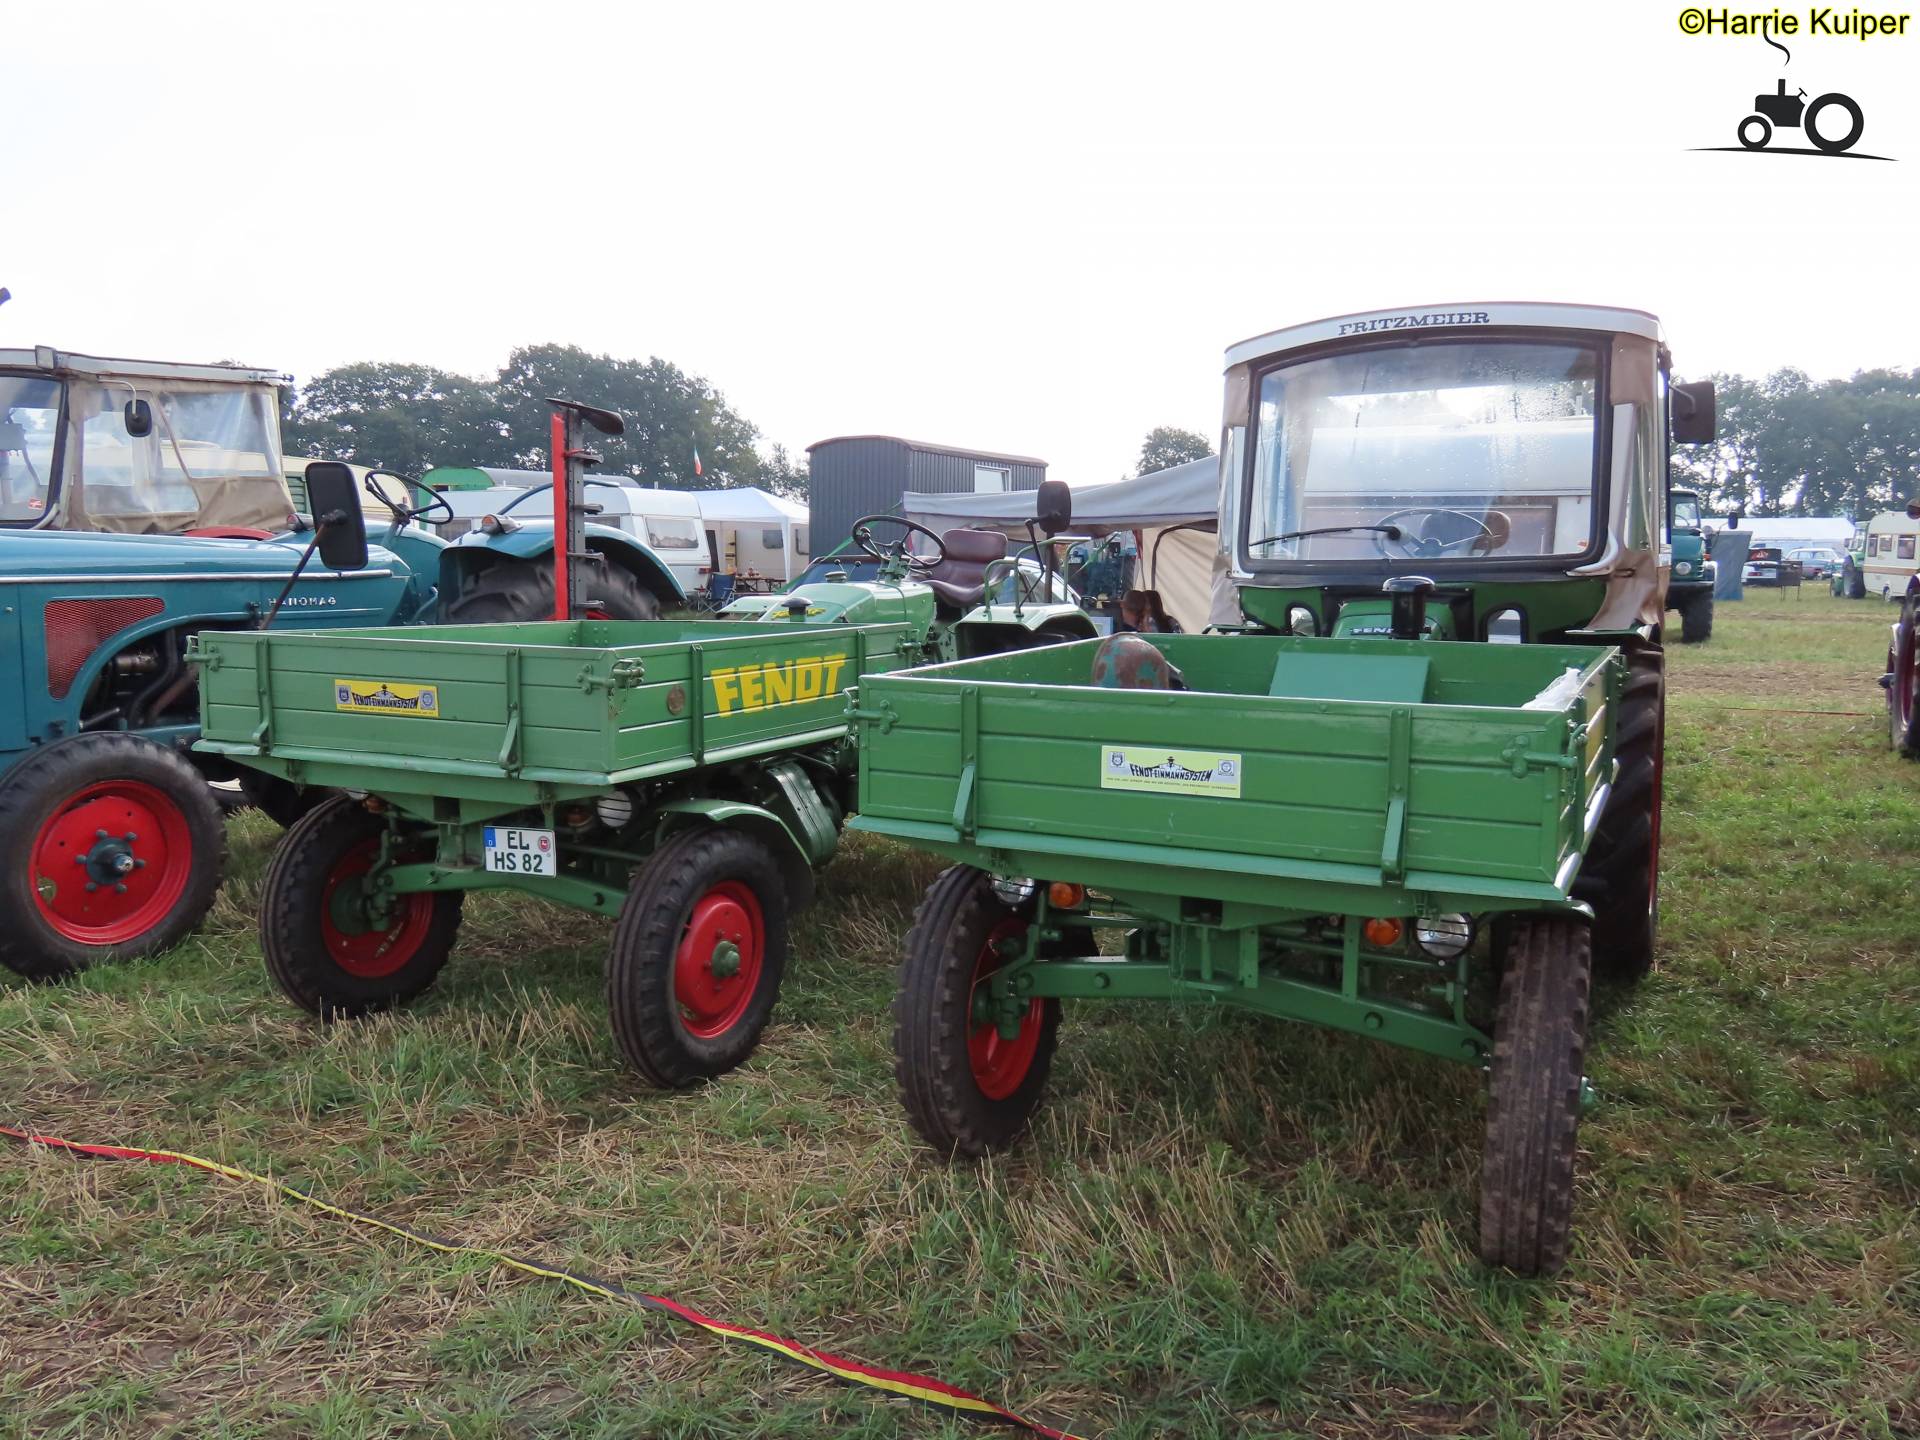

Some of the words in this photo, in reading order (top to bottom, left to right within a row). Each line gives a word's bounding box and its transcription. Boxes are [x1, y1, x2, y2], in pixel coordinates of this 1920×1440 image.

[1338, 312, 1490, 336] FRITZMEIER
[711, 653, 846, 718] FENDT
[507, 830, 530, 850] EL
[494, 851, 517, 871] HS
[522, 853, 543, 873] 82
